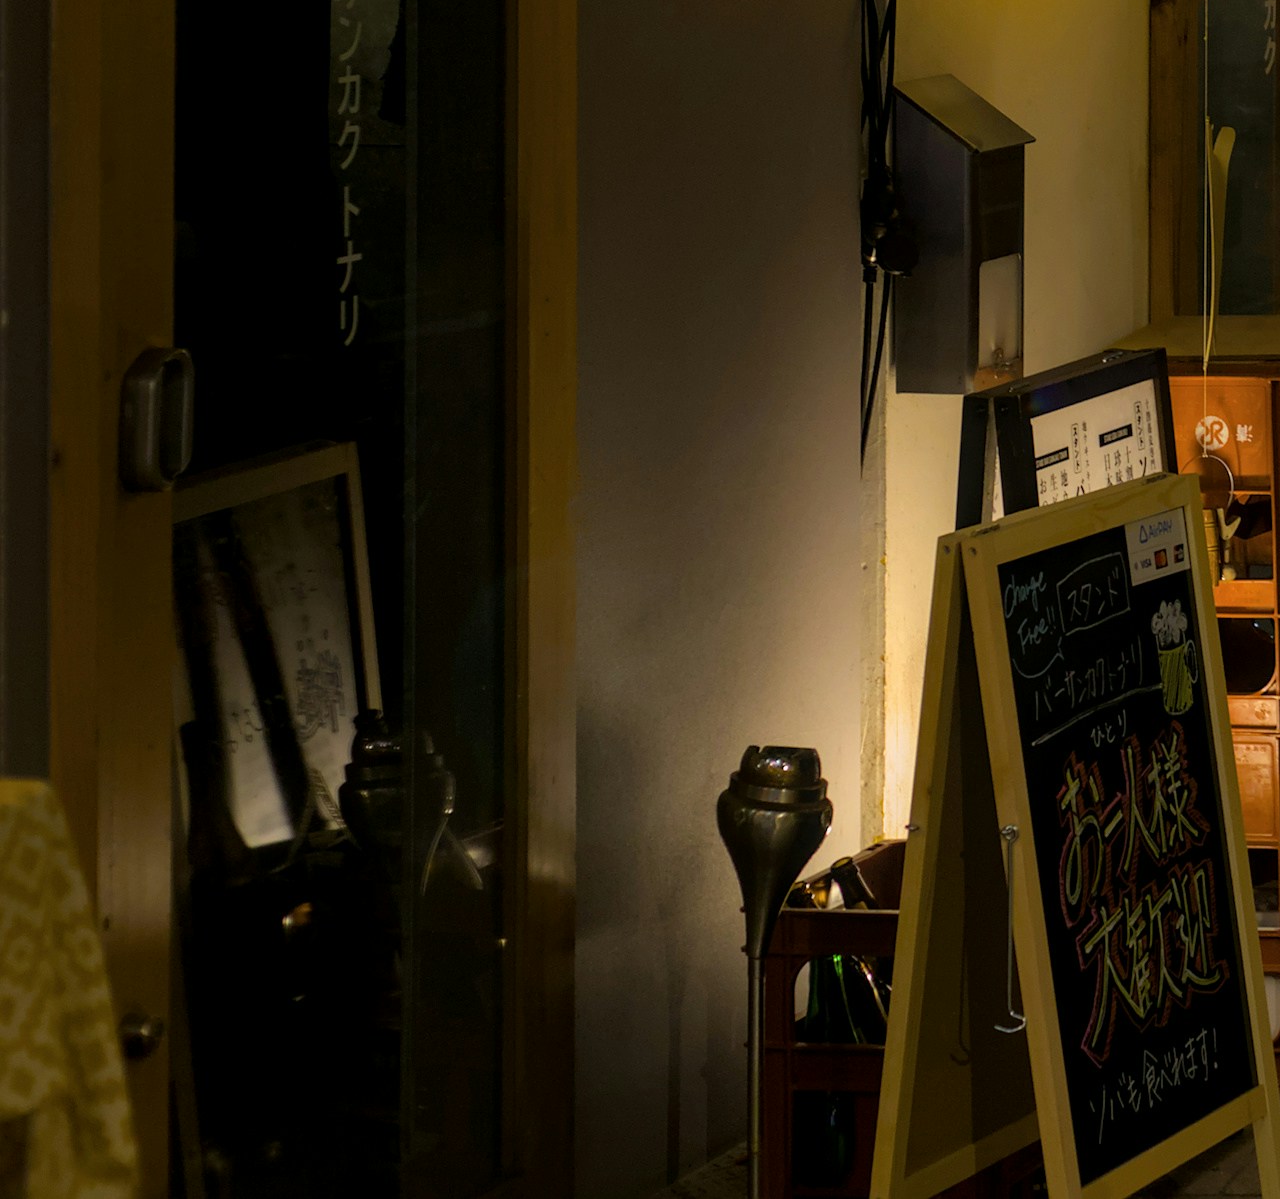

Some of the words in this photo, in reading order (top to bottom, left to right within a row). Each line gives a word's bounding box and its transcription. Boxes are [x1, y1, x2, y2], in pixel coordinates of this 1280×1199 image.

[1068, 565, 1120, 623] スタンド
[1017, 604, 1057, 655] Free!!
[1090, 708, 1127, 749] ひとり
[1059, 726, 1204, 912] お一人様
[1081, 866, 1223, 1054] 大歓迎
